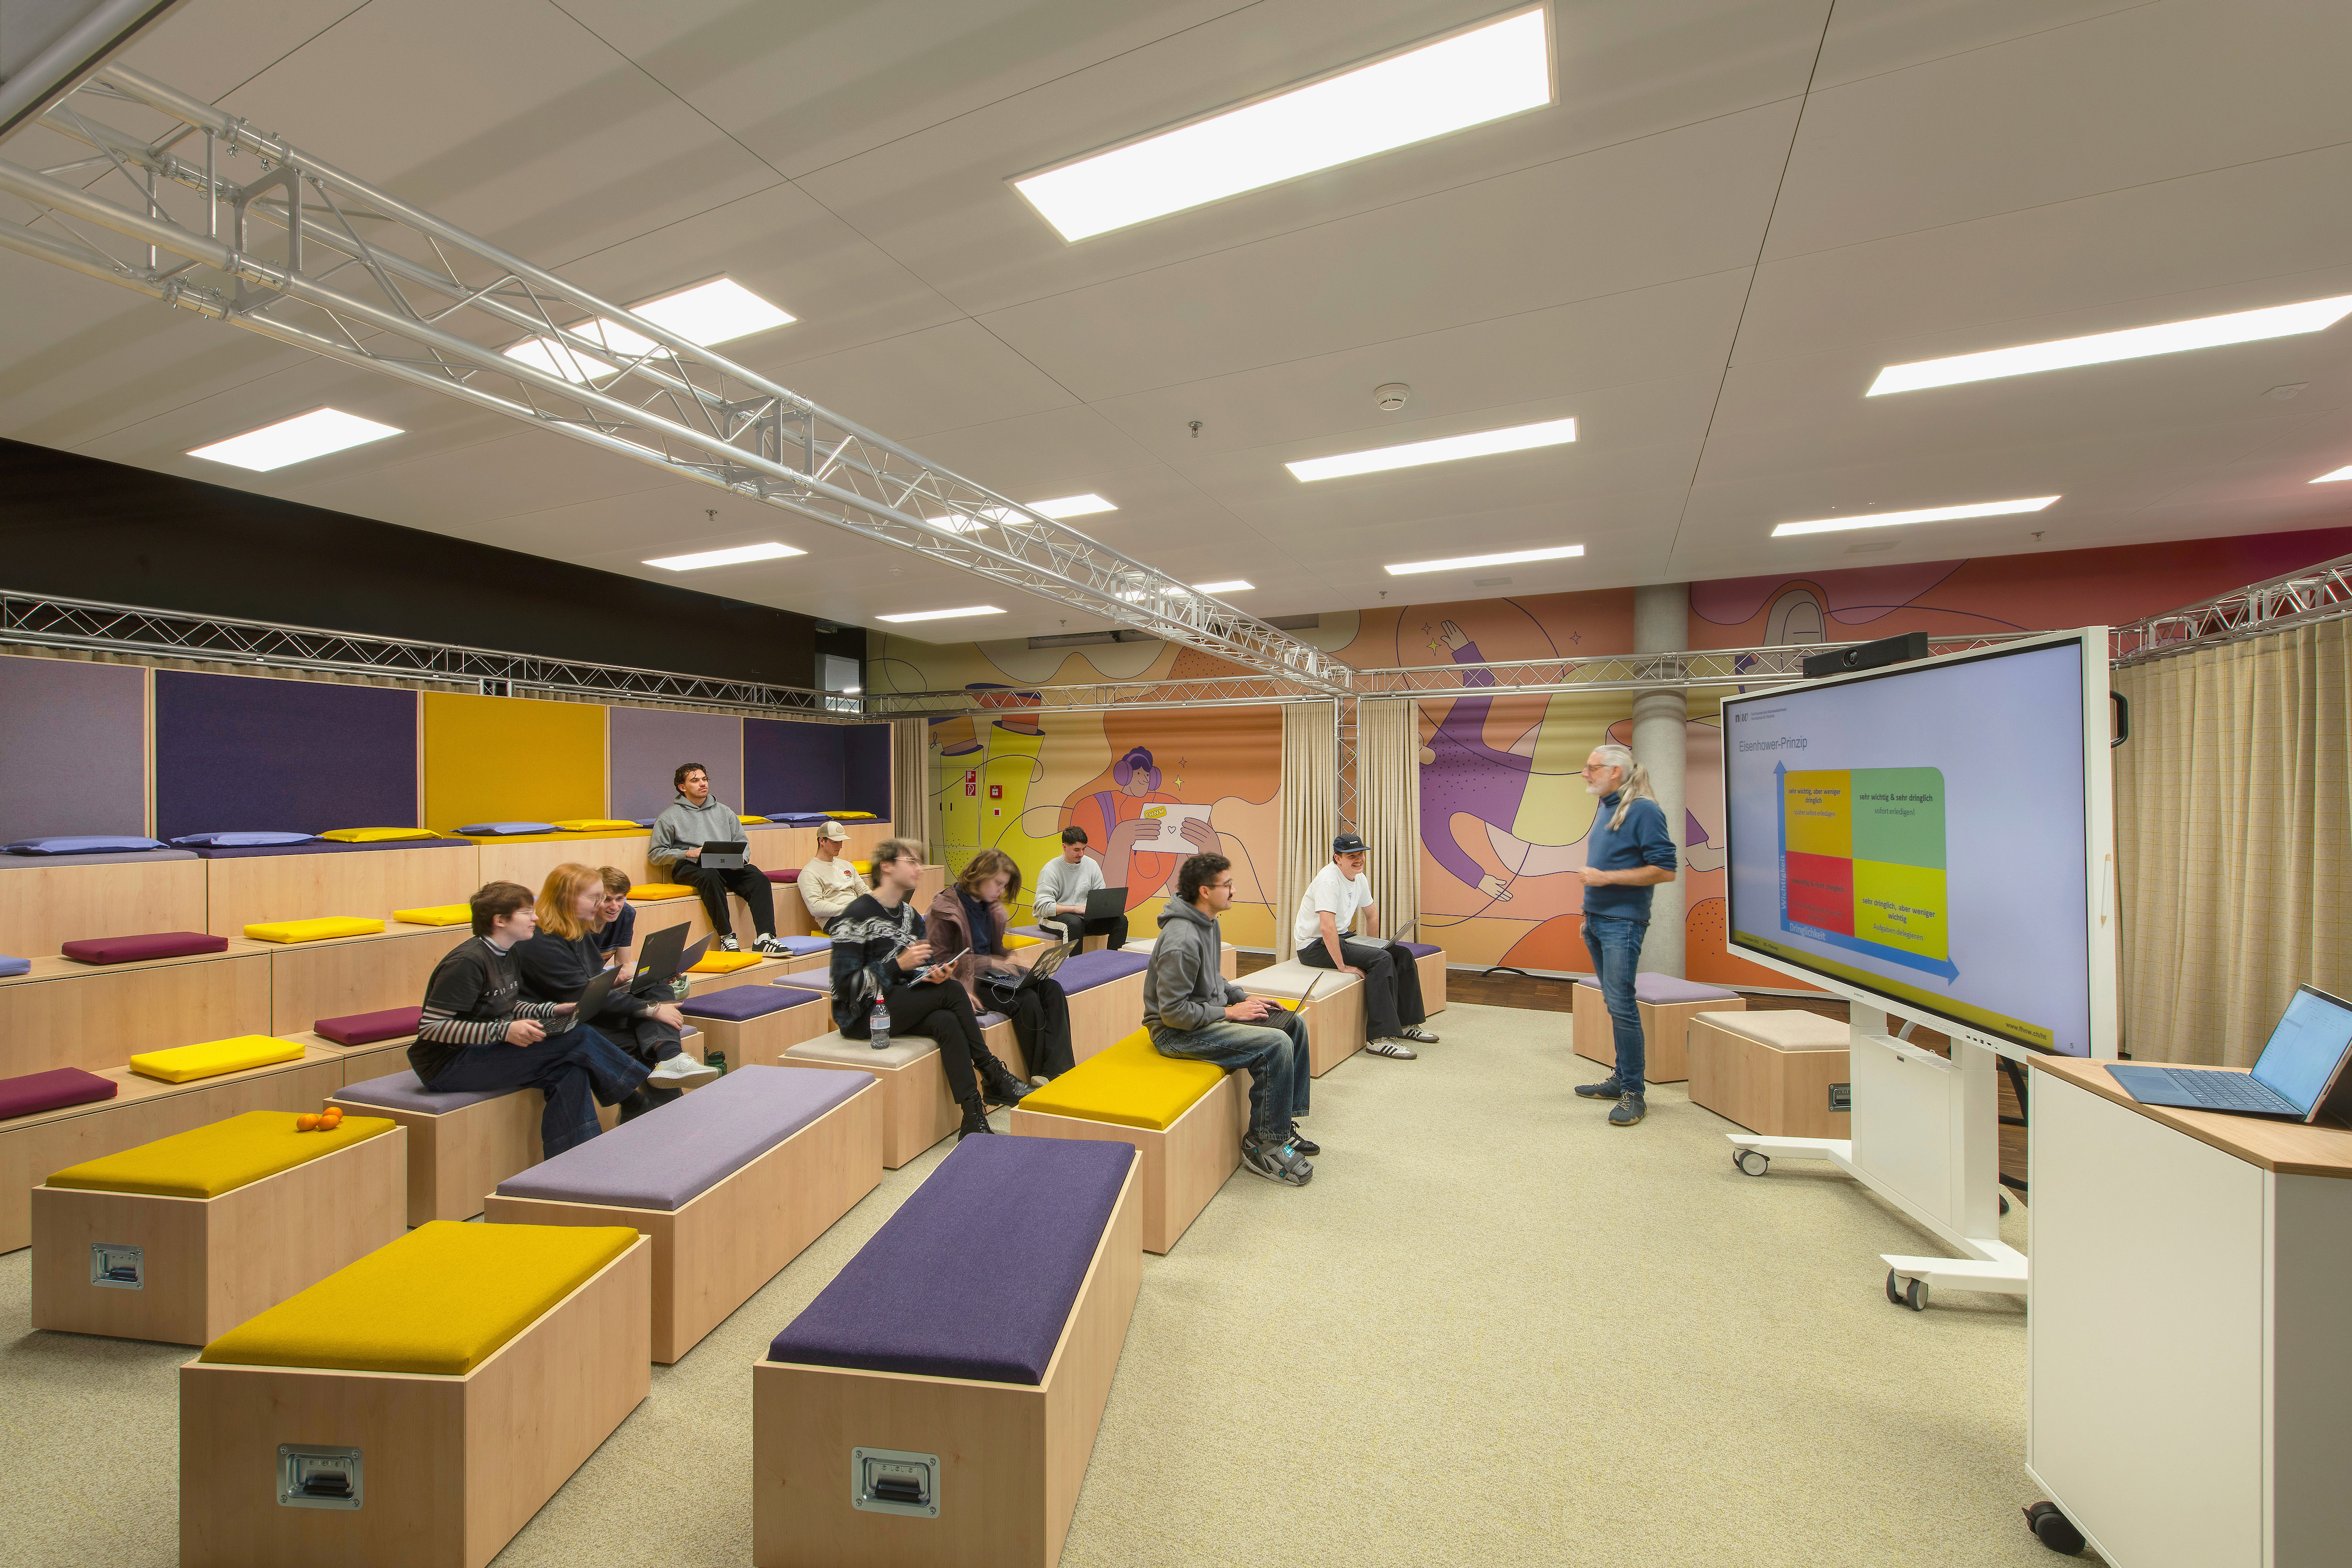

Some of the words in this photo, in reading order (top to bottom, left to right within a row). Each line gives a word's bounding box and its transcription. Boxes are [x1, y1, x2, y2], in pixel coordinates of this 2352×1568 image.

[1739, 735, 1808, 752] Eisenhower-Prinzip
[1871, 794, 1889, 802] wichtig
[1909, 794, 1933, 803] dringlich
[1145, 807, 1165, 818] FHNW
[1889, 808, 1915, 817] erledigen!
[1826, 884, 1844, 893] dringlich
[1874, 900, 1896, 911] dringlich,
[1912, 908, 1935, 918] weniger
[1888, 913, 1907, 924] wichtig
[1790, 922, 1826, 941] Dringlichkeit
[1873, 923, 1896, 934] Aufgaben
[1896, 928, 1923, 941] delegieren
[2005, 1022, 2046, 1040] www.fhnw.ch/ht
